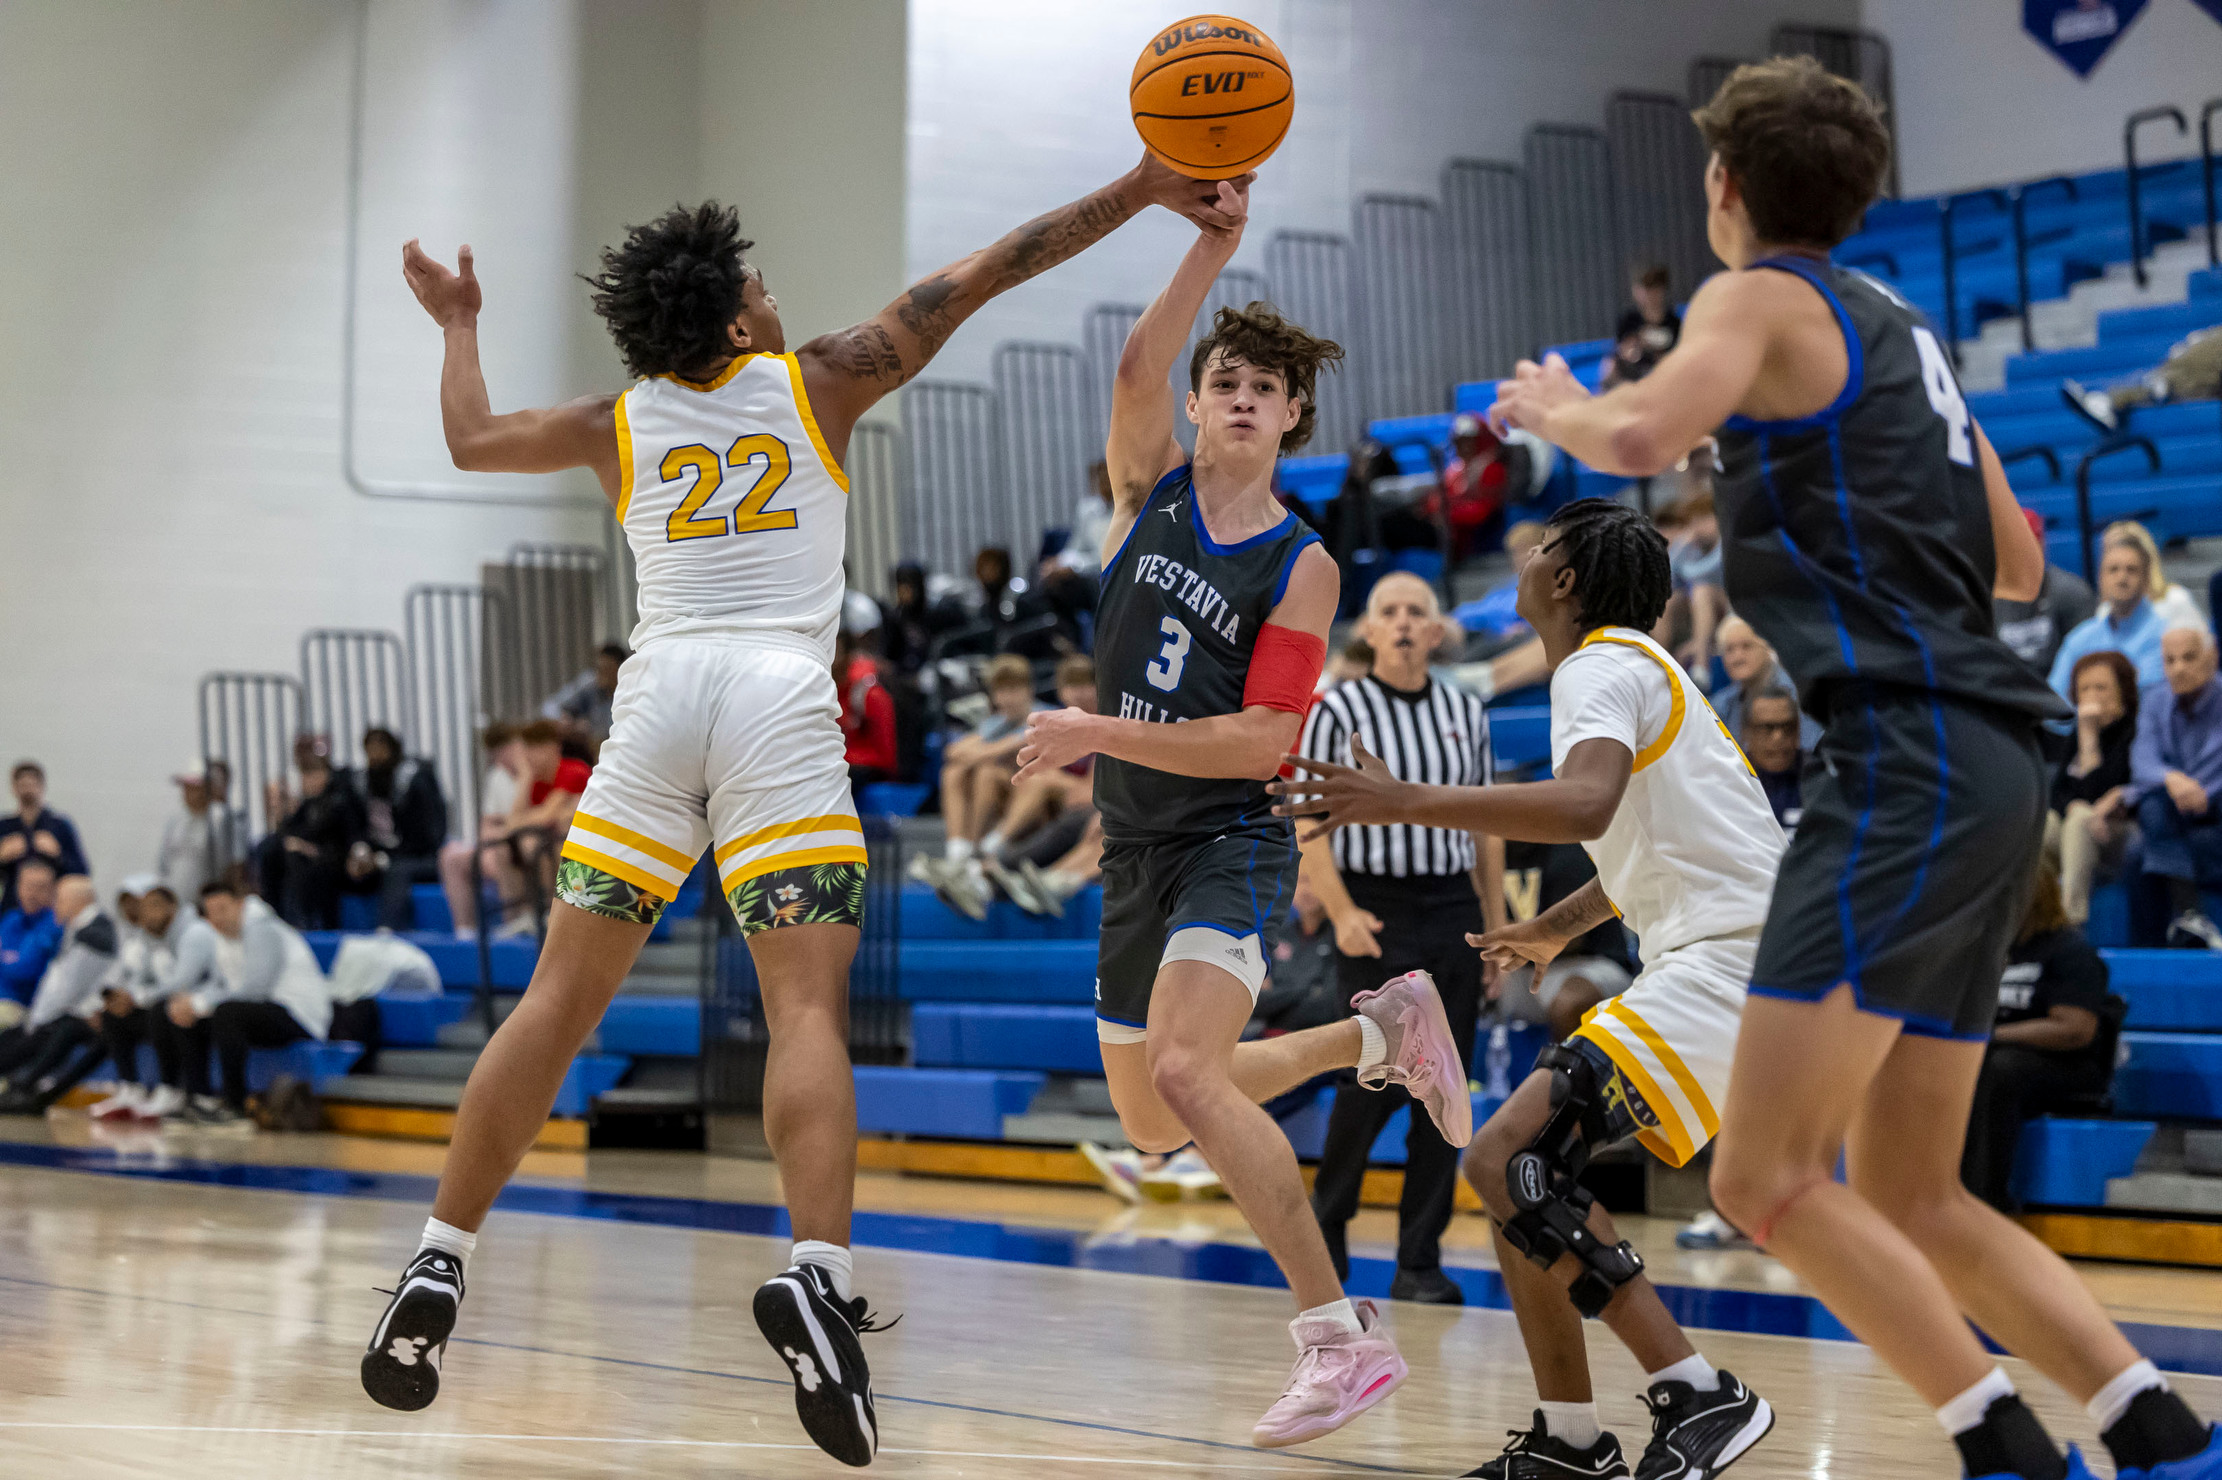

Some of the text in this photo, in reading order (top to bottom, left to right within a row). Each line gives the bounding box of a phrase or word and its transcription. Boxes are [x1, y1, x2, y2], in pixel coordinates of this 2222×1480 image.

[1152, 22, 1261, 56] Wilson
[1181, 71, 1246, 97] EVO
[1911, 325, 1974, 467] 4
[659, 433, 799, 543] 22
[1134, 554, 1240, 645] VESTAVIA
[1145, 615, 1193, 693] 3
